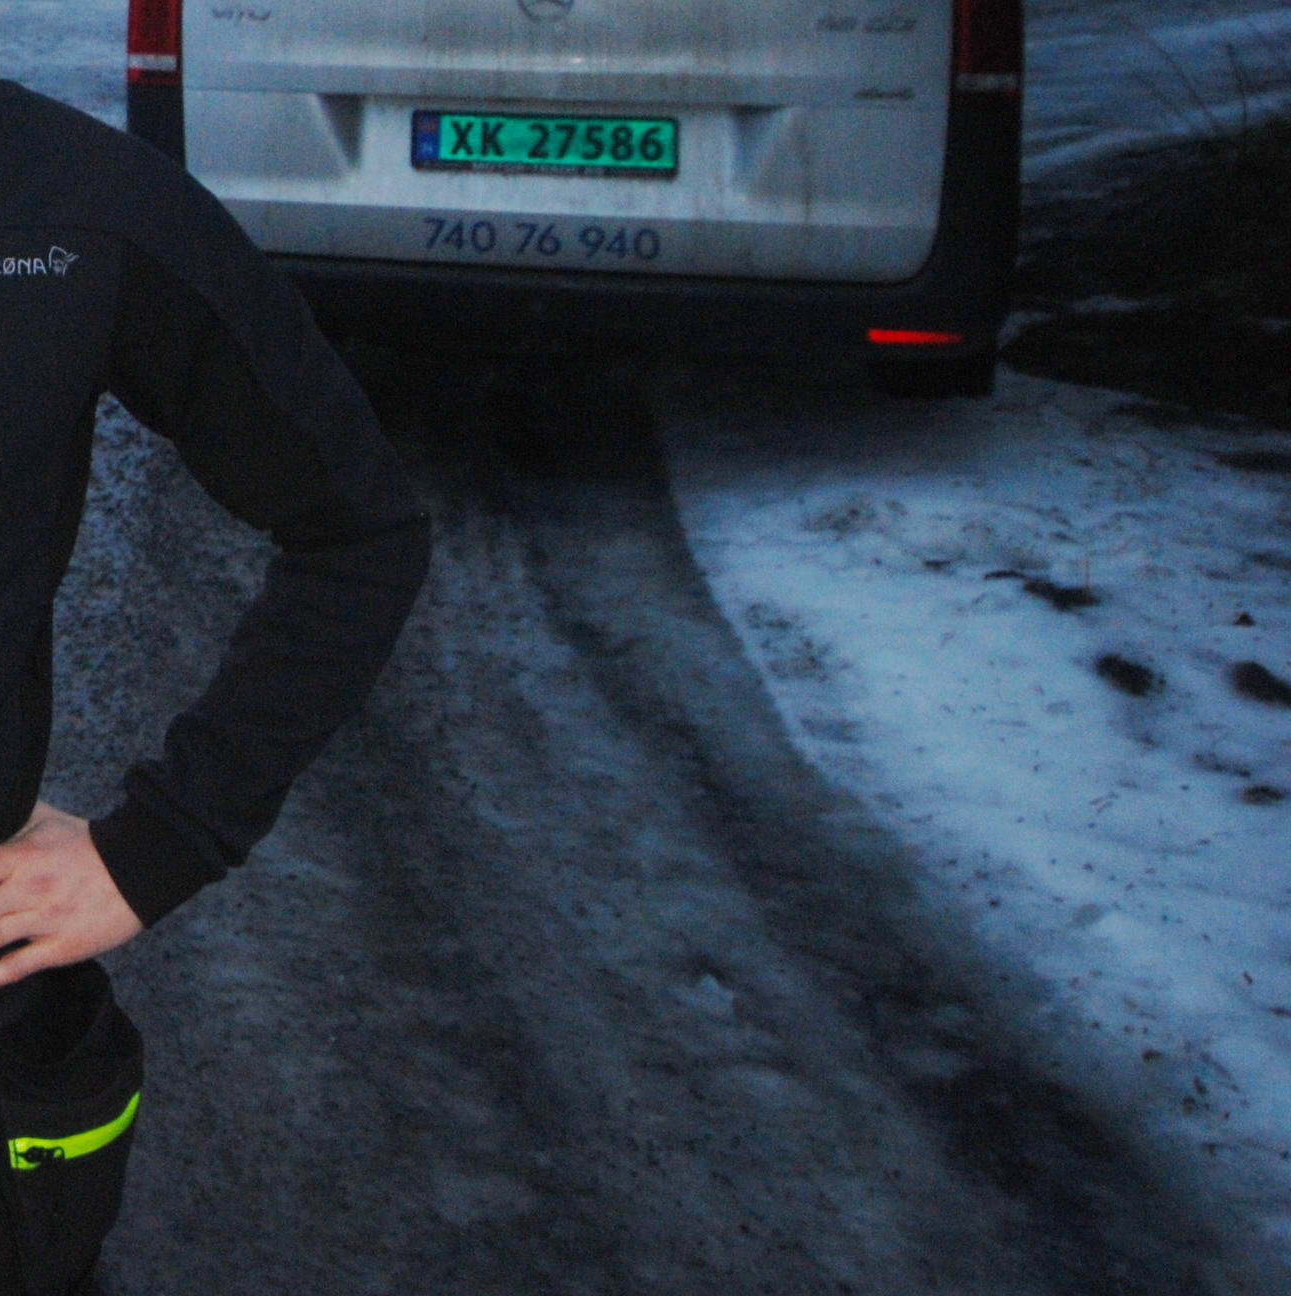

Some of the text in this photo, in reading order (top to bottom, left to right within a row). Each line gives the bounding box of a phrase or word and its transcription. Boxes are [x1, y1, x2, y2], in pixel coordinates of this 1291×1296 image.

[450, 120, 664, 162] XK 27586
[422, 216, 661, 260] 740 76 940
